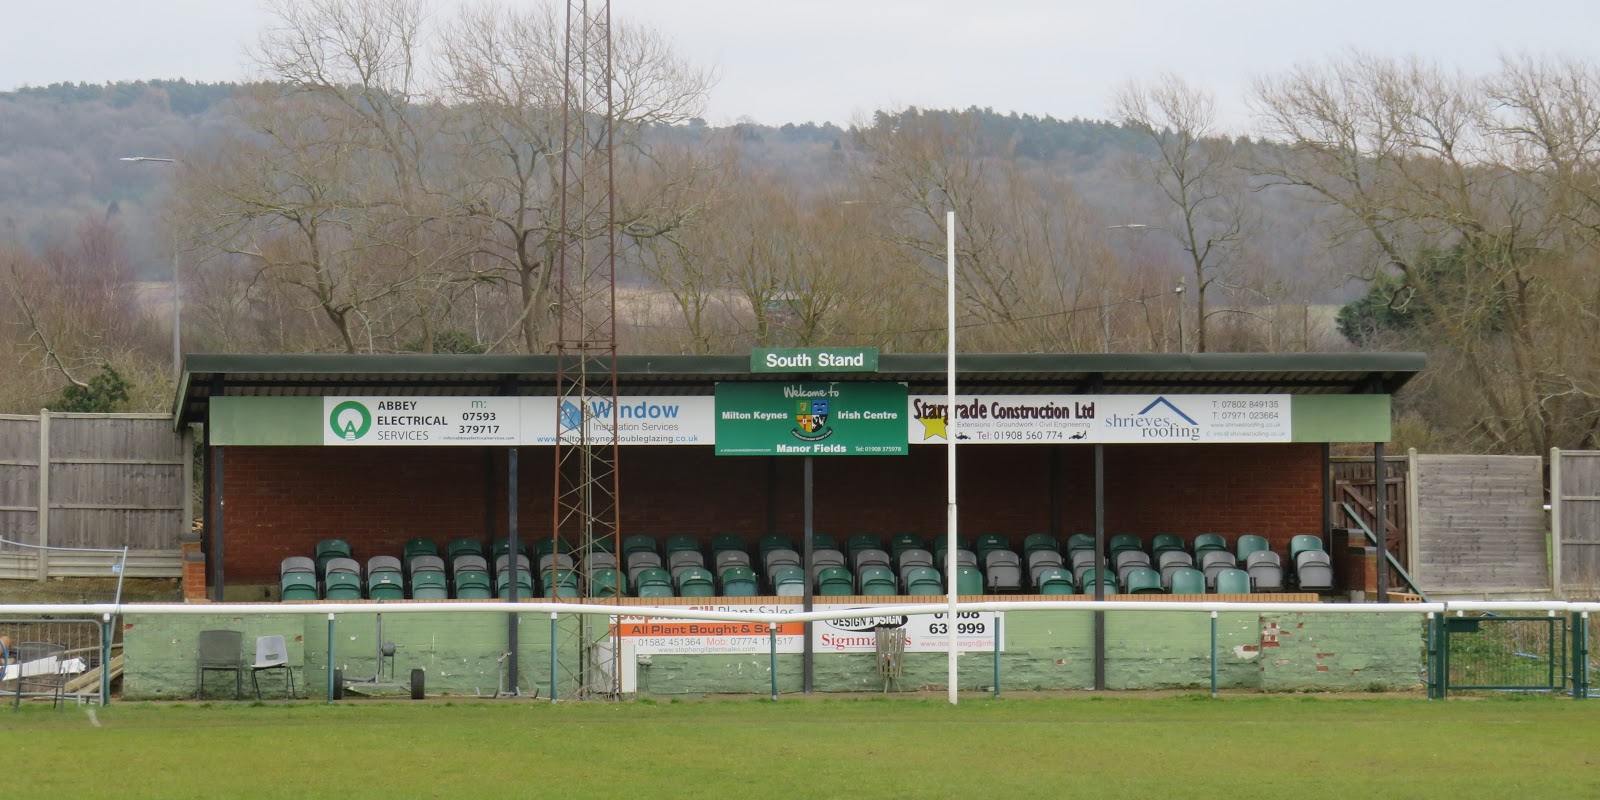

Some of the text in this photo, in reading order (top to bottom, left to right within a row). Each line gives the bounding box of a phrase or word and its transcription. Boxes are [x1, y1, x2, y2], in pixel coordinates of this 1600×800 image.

[766, 353, 864, 367] South Stand
[783, 384, 840, 398] Welcome to
[378, 401, 417, 411] ABBEY
[471, 400, 487, 409] m:
[591, 401, 679, 419] Wndow
[991, 402, 1070, 420] Construction
[1075, 401, 1095, 419] Ltd
[462, 412, 496, 421] 07593
[722, 410, 898, 421] Milton Keynes Irish Centre
[1105, 413, 1170, 428] shrieves
[1212, 412, 1279, 420] T: 07971 023664
[377, 416, 448, 426] ELECTRICAL
[1054, 421, 1091, 429] Engineering
[459, 425, 500, 434] 379717
[593, 422, 679, 432] Instaation Services
[1142, 423, 1200, 441] roofing
[377, 431, 429, 441] SERVICES
[977, 430, 1063, 440] Tel: 01908 560 774
[776, 444, 811, 453] Manor
[814, 444, 847, 453] Fields
[879, 615, 902, 625] SIGN
[632, 624, 783, 636] All Plant Bought & Sod
[929, 623, 985, 634] 63999
[638, 638, 666, 647] 01582
[668, 638, 701, 646] 451364
[706, 637, 728, 646] Mob:
[730, 637, 758, 646] 07774
[762, 637, 794, 646] 17517
[821, 633, 912, 650] Signmas
